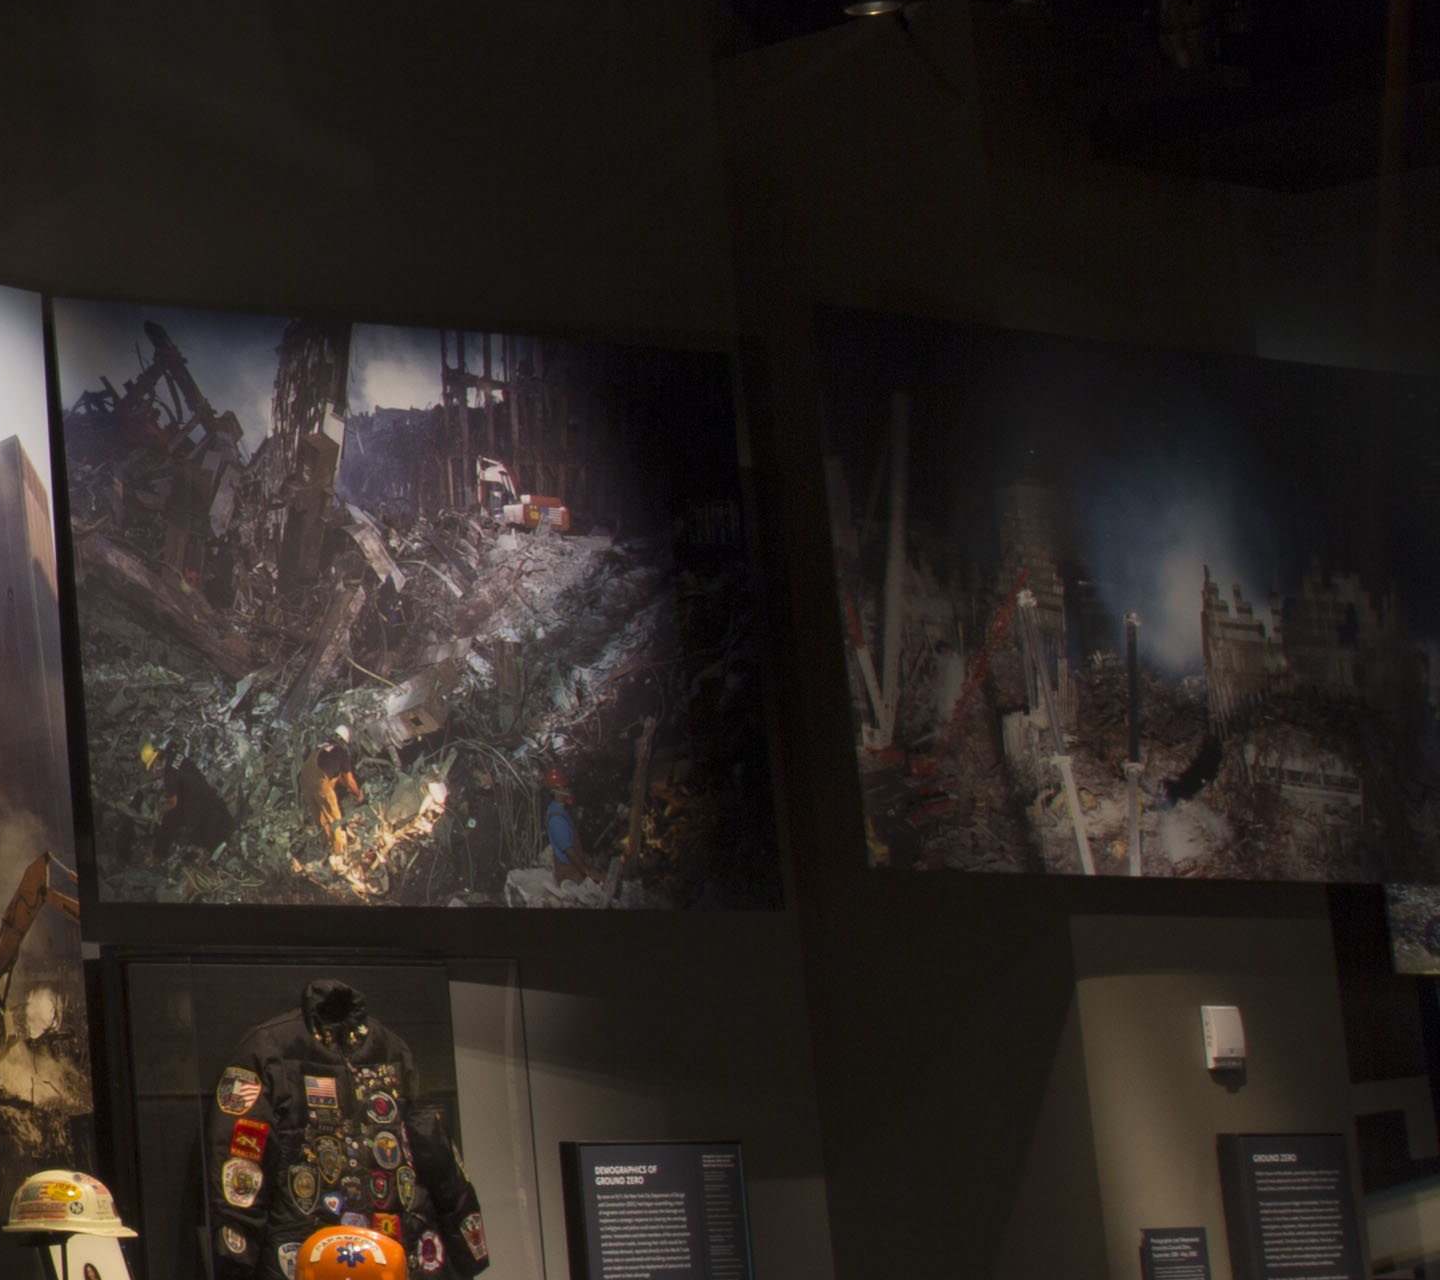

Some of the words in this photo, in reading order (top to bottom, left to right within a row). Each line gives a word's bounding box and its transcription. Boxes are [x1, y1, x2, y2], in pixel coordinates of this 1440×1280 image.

[594, 1165, 647, 1175] DEMOGRAPHICS
[647, 1164, 657, 1173] OF
[595, 1176, 625, 1185] GROUND
[626, 1175, 644, 1184] ZERO
